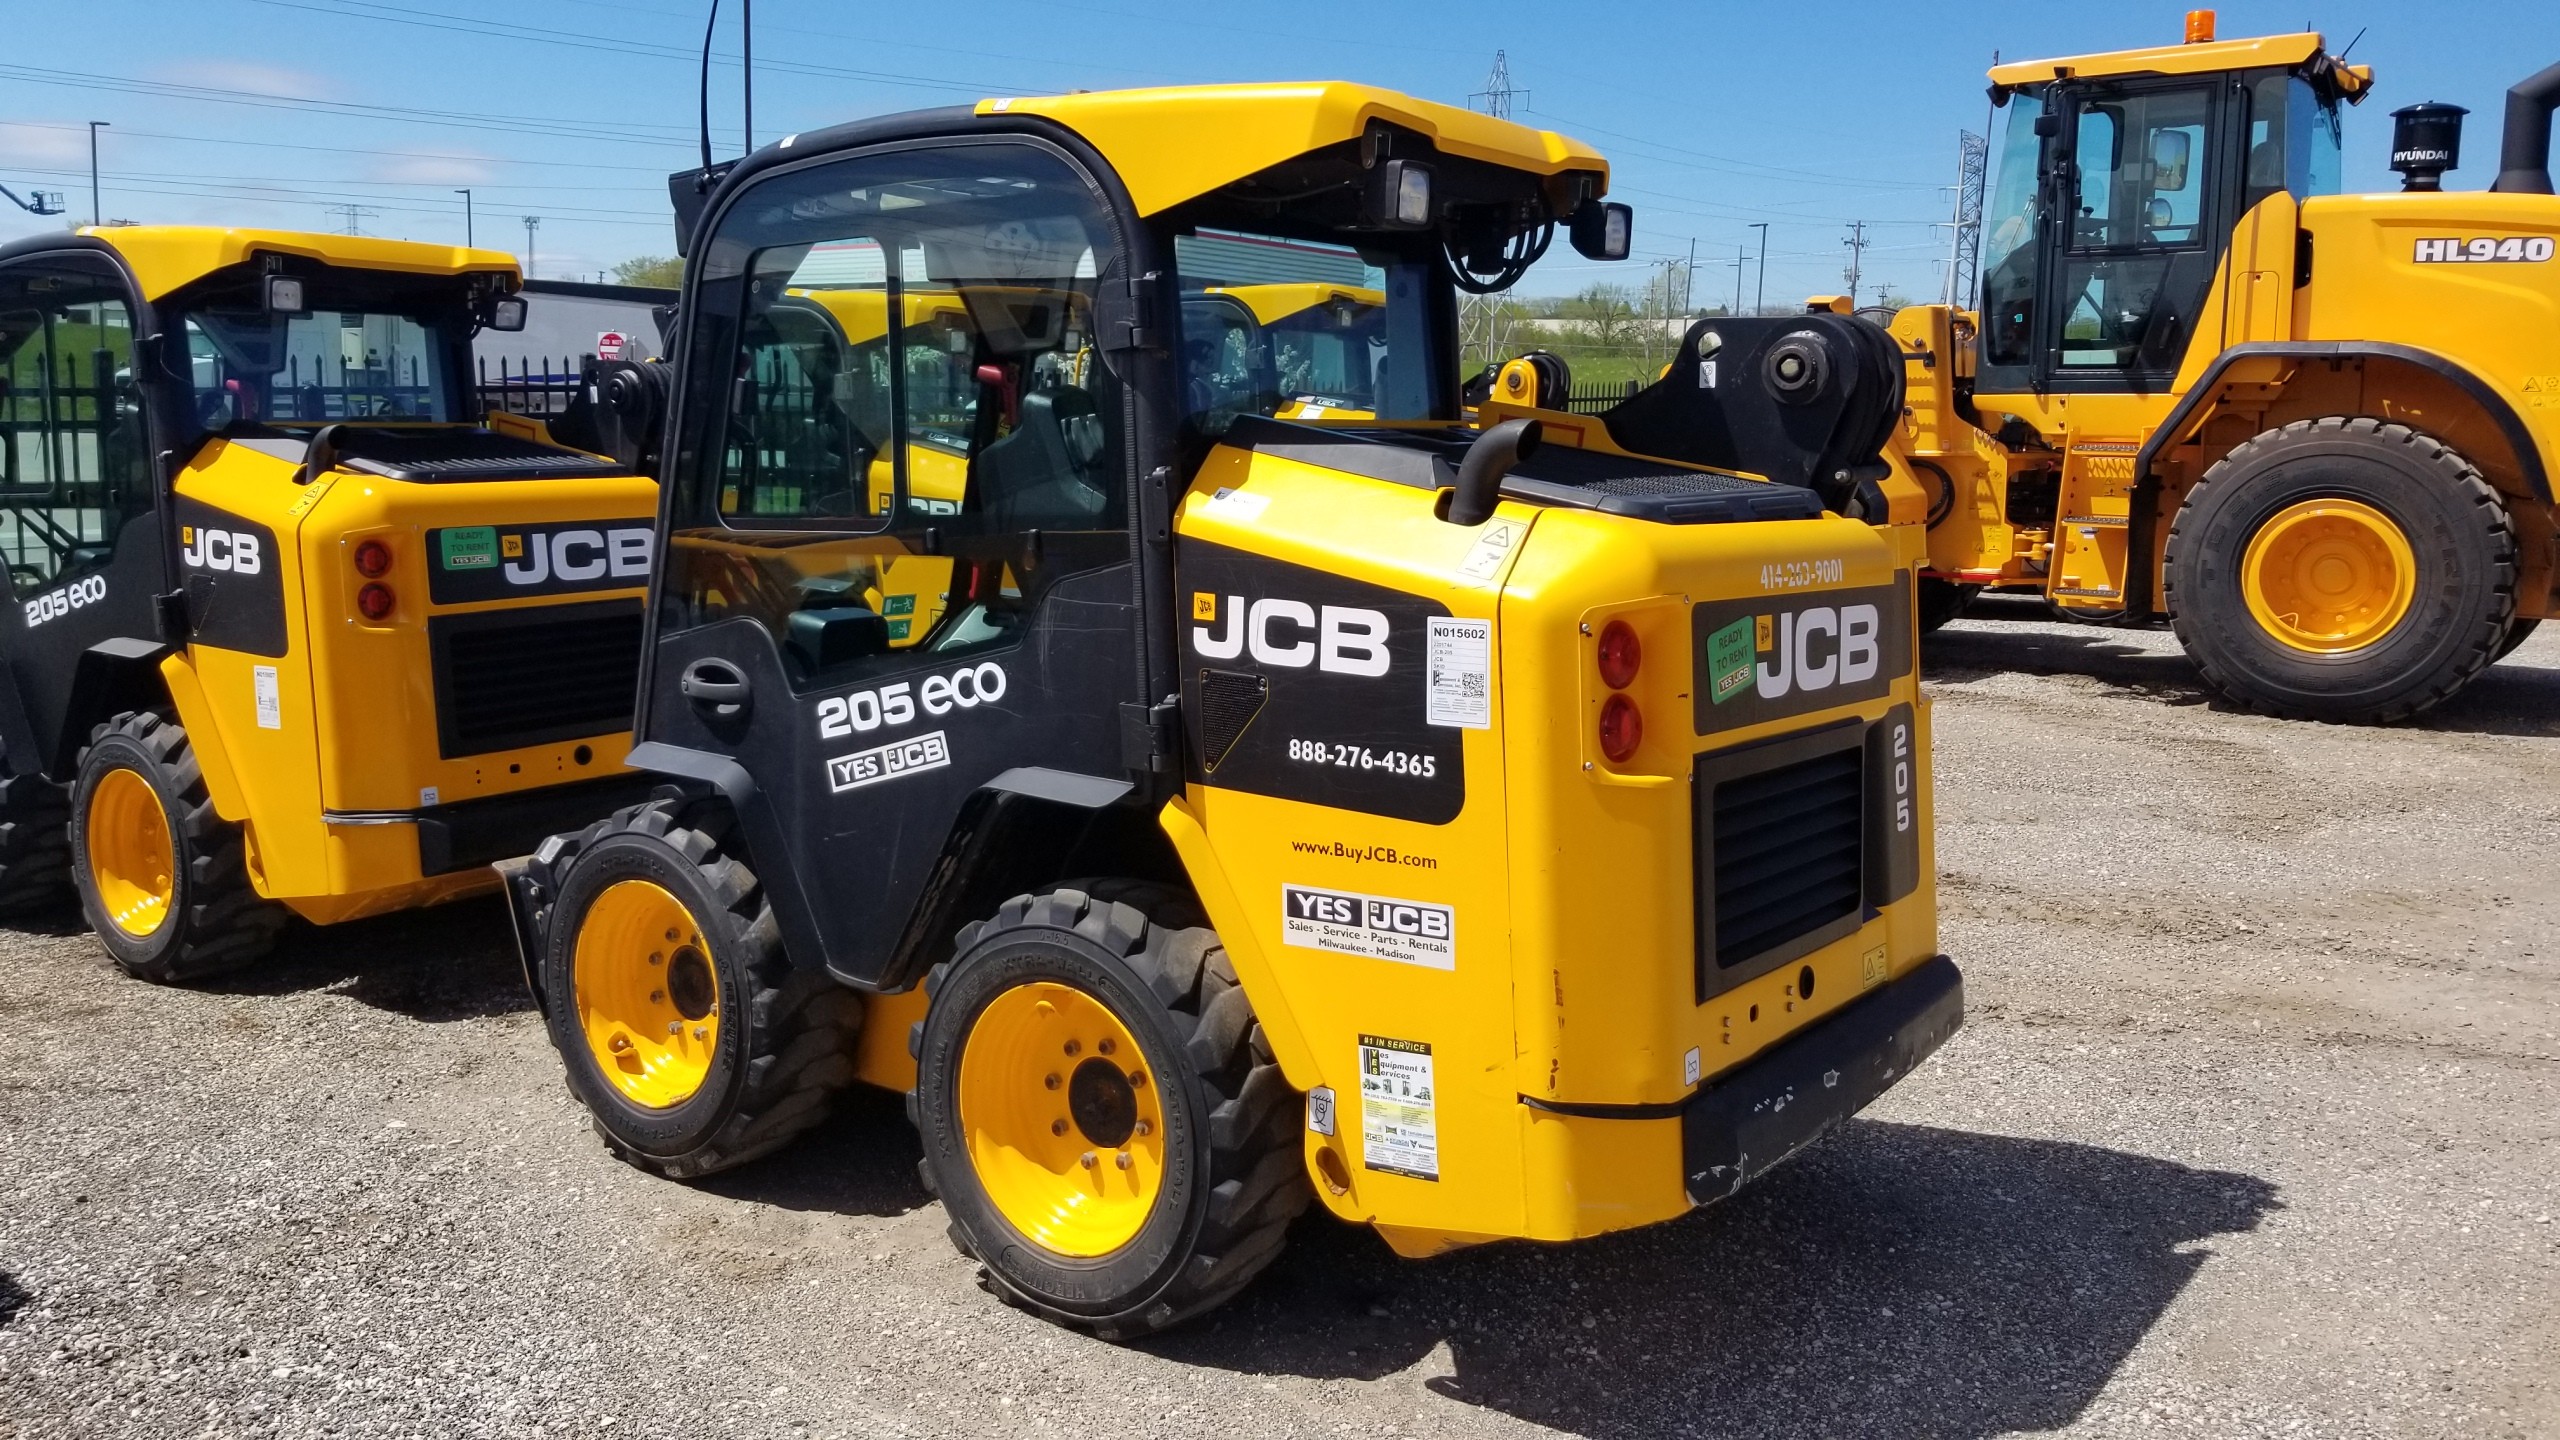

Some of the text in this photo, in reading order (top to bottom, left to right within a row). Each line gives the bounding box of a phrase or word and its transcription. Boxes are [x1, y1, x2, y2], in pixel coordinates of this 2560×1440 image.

[2394, 150, 2448, 162] HYUNDAI
[2414, 237, 2555, 262] HL940
[183, 528, 261, 574] JCB
[466, 543, 490, 551] RENT
[505, 528, 654, 585] JCB
[1760, 559, 1843, 589] 414-263-9001
[26, 575, 106, 628] 205 eco
[1193, 596, 1390, 677] JCB
[1433, 627, 1485, 640] N015602
[1718, 627, 1743, 650] READY
[1716, 645, 1748, 672] TO RENT
[1756, 604, 1879, 699] JCB
[1720, 667, 1749, 690] YES JCB
[817, 661, 1007, 739] 205 eco
[838, 738, 944, 782] YES JCB
[1288, 738, 1436, 777] 888-276-4365
[1292, 840, 1437, 870] www.BuyJCB.com
[1296, 893, 1448, 938] YES JCB
[1288, 920, 1314, 933] Sales
[1323, 925, 1360, 940] Service
[1370, 933, 1398, 946] Parts
[1408, 938, 1448, 953] Rentals
[1318, 938, 1367, 953] Milwaukee
[1376, 946, 1416, 961] Madison
[1364, 1036, 1426, 1052] #1 IN SERVICE
